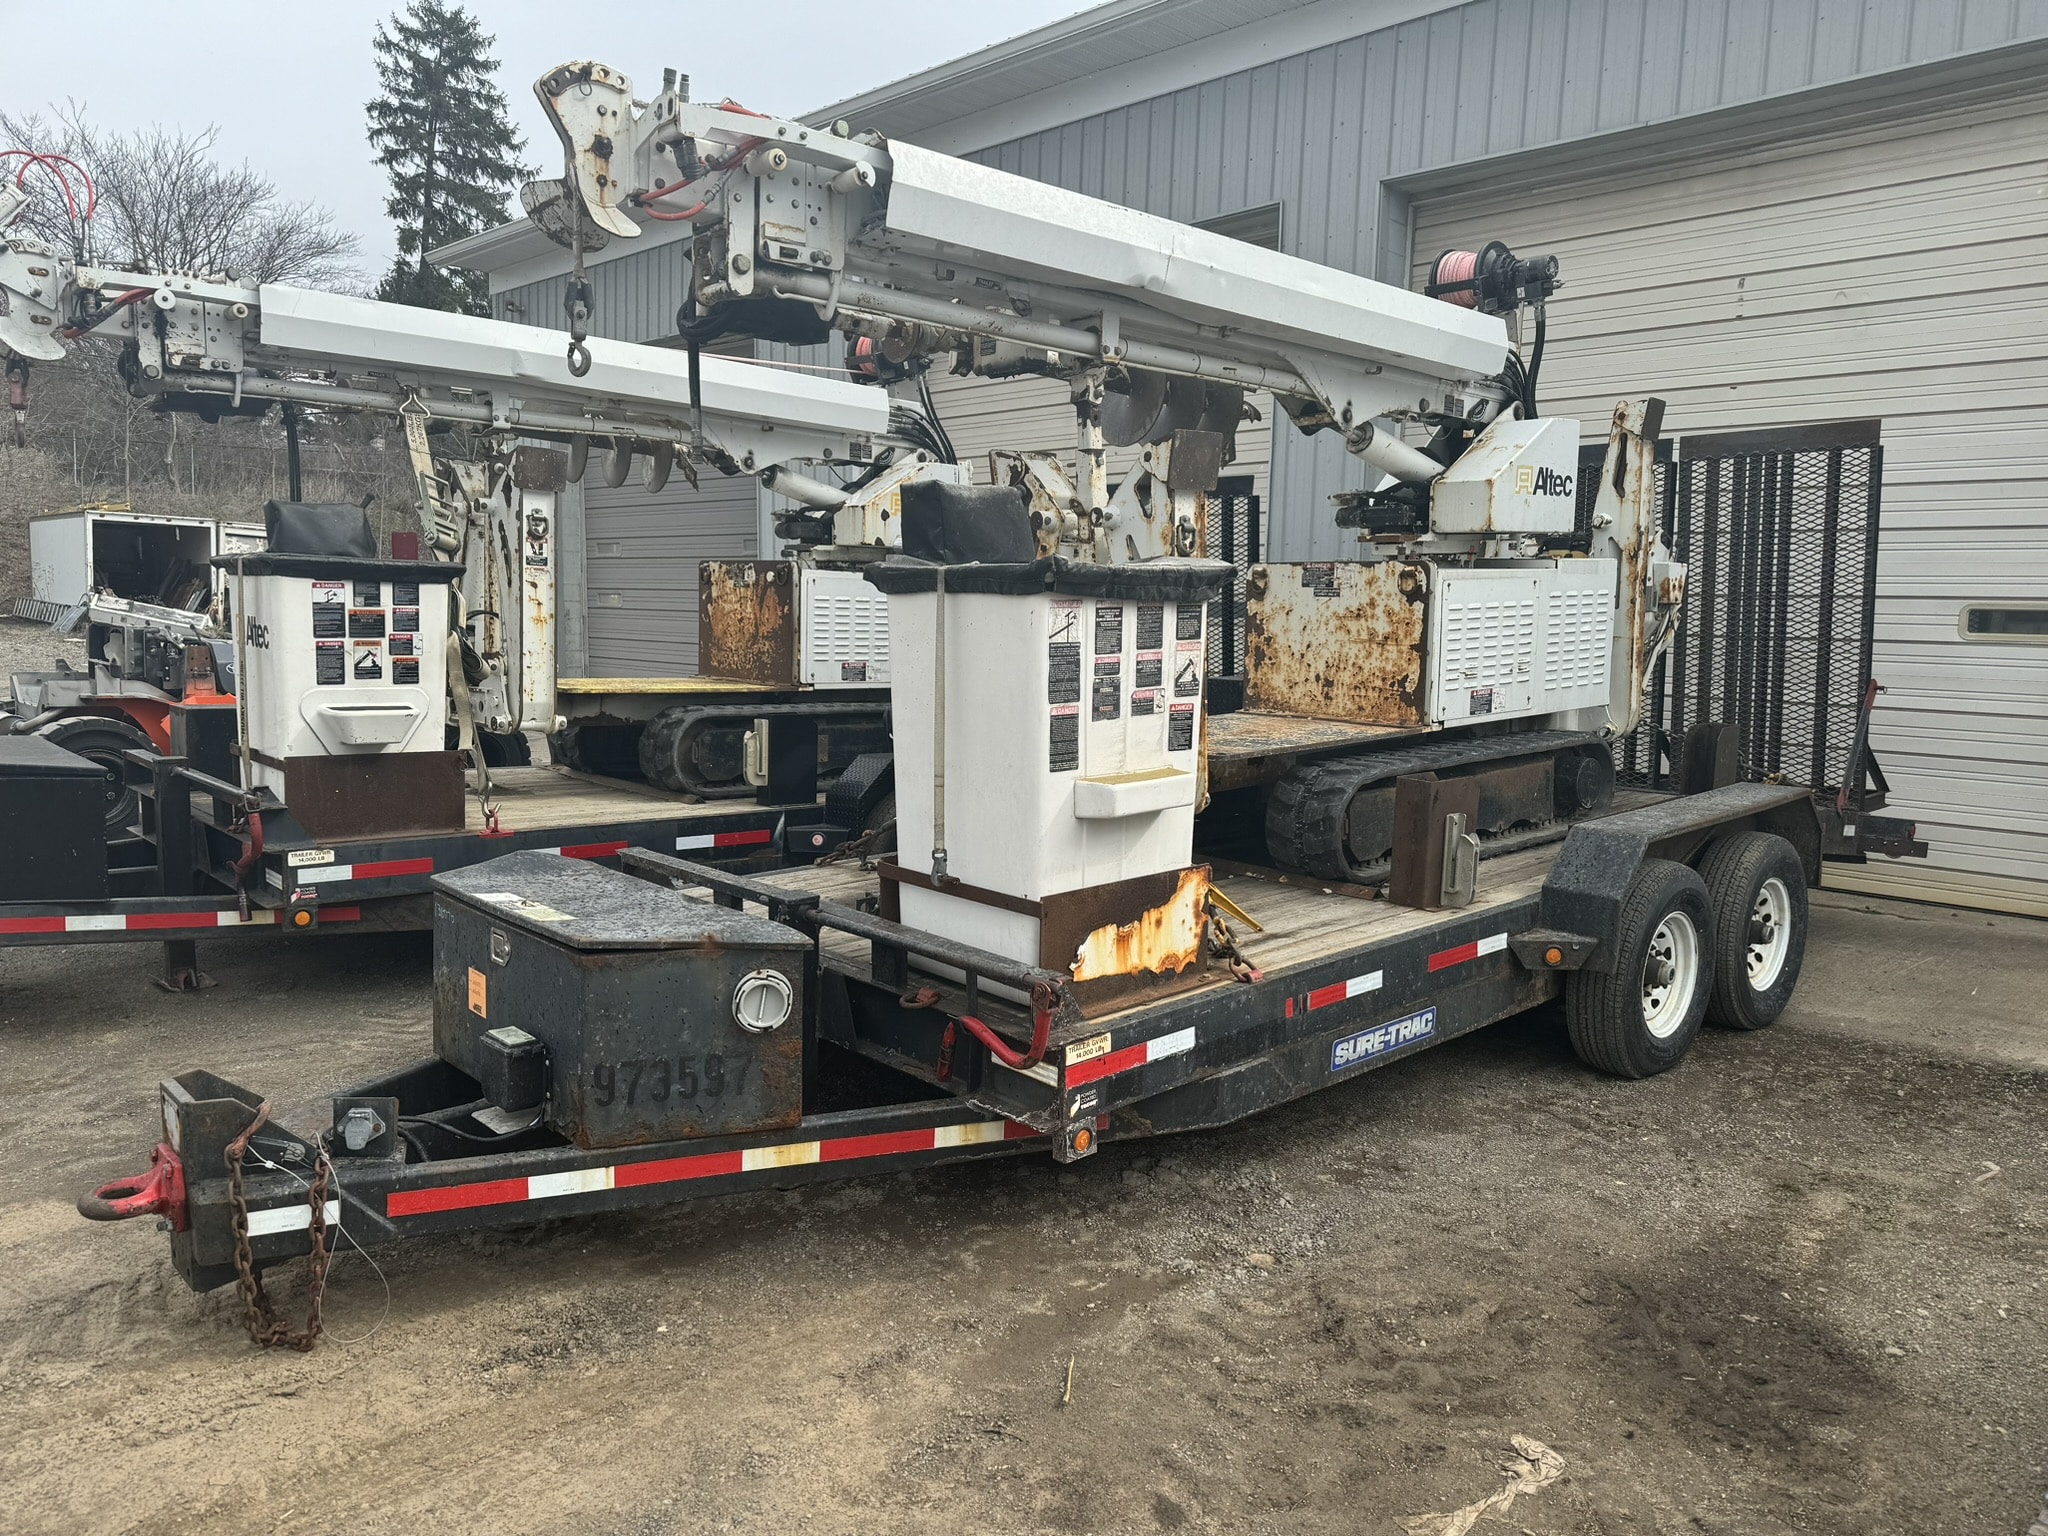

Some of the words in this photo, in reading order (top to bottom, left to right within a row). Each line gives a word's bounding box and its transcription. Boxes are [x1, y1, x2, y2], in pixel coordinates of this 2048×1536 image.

[1532, 466, 1573, 497] Altec
[246, 615, 270, 650] Altec
[1069, 1042, 1090, 1054] TRAILER
[1334, 1012, 1433, 1065] SURE-TRAC
[593, 1051, 754, 1107] 973597
